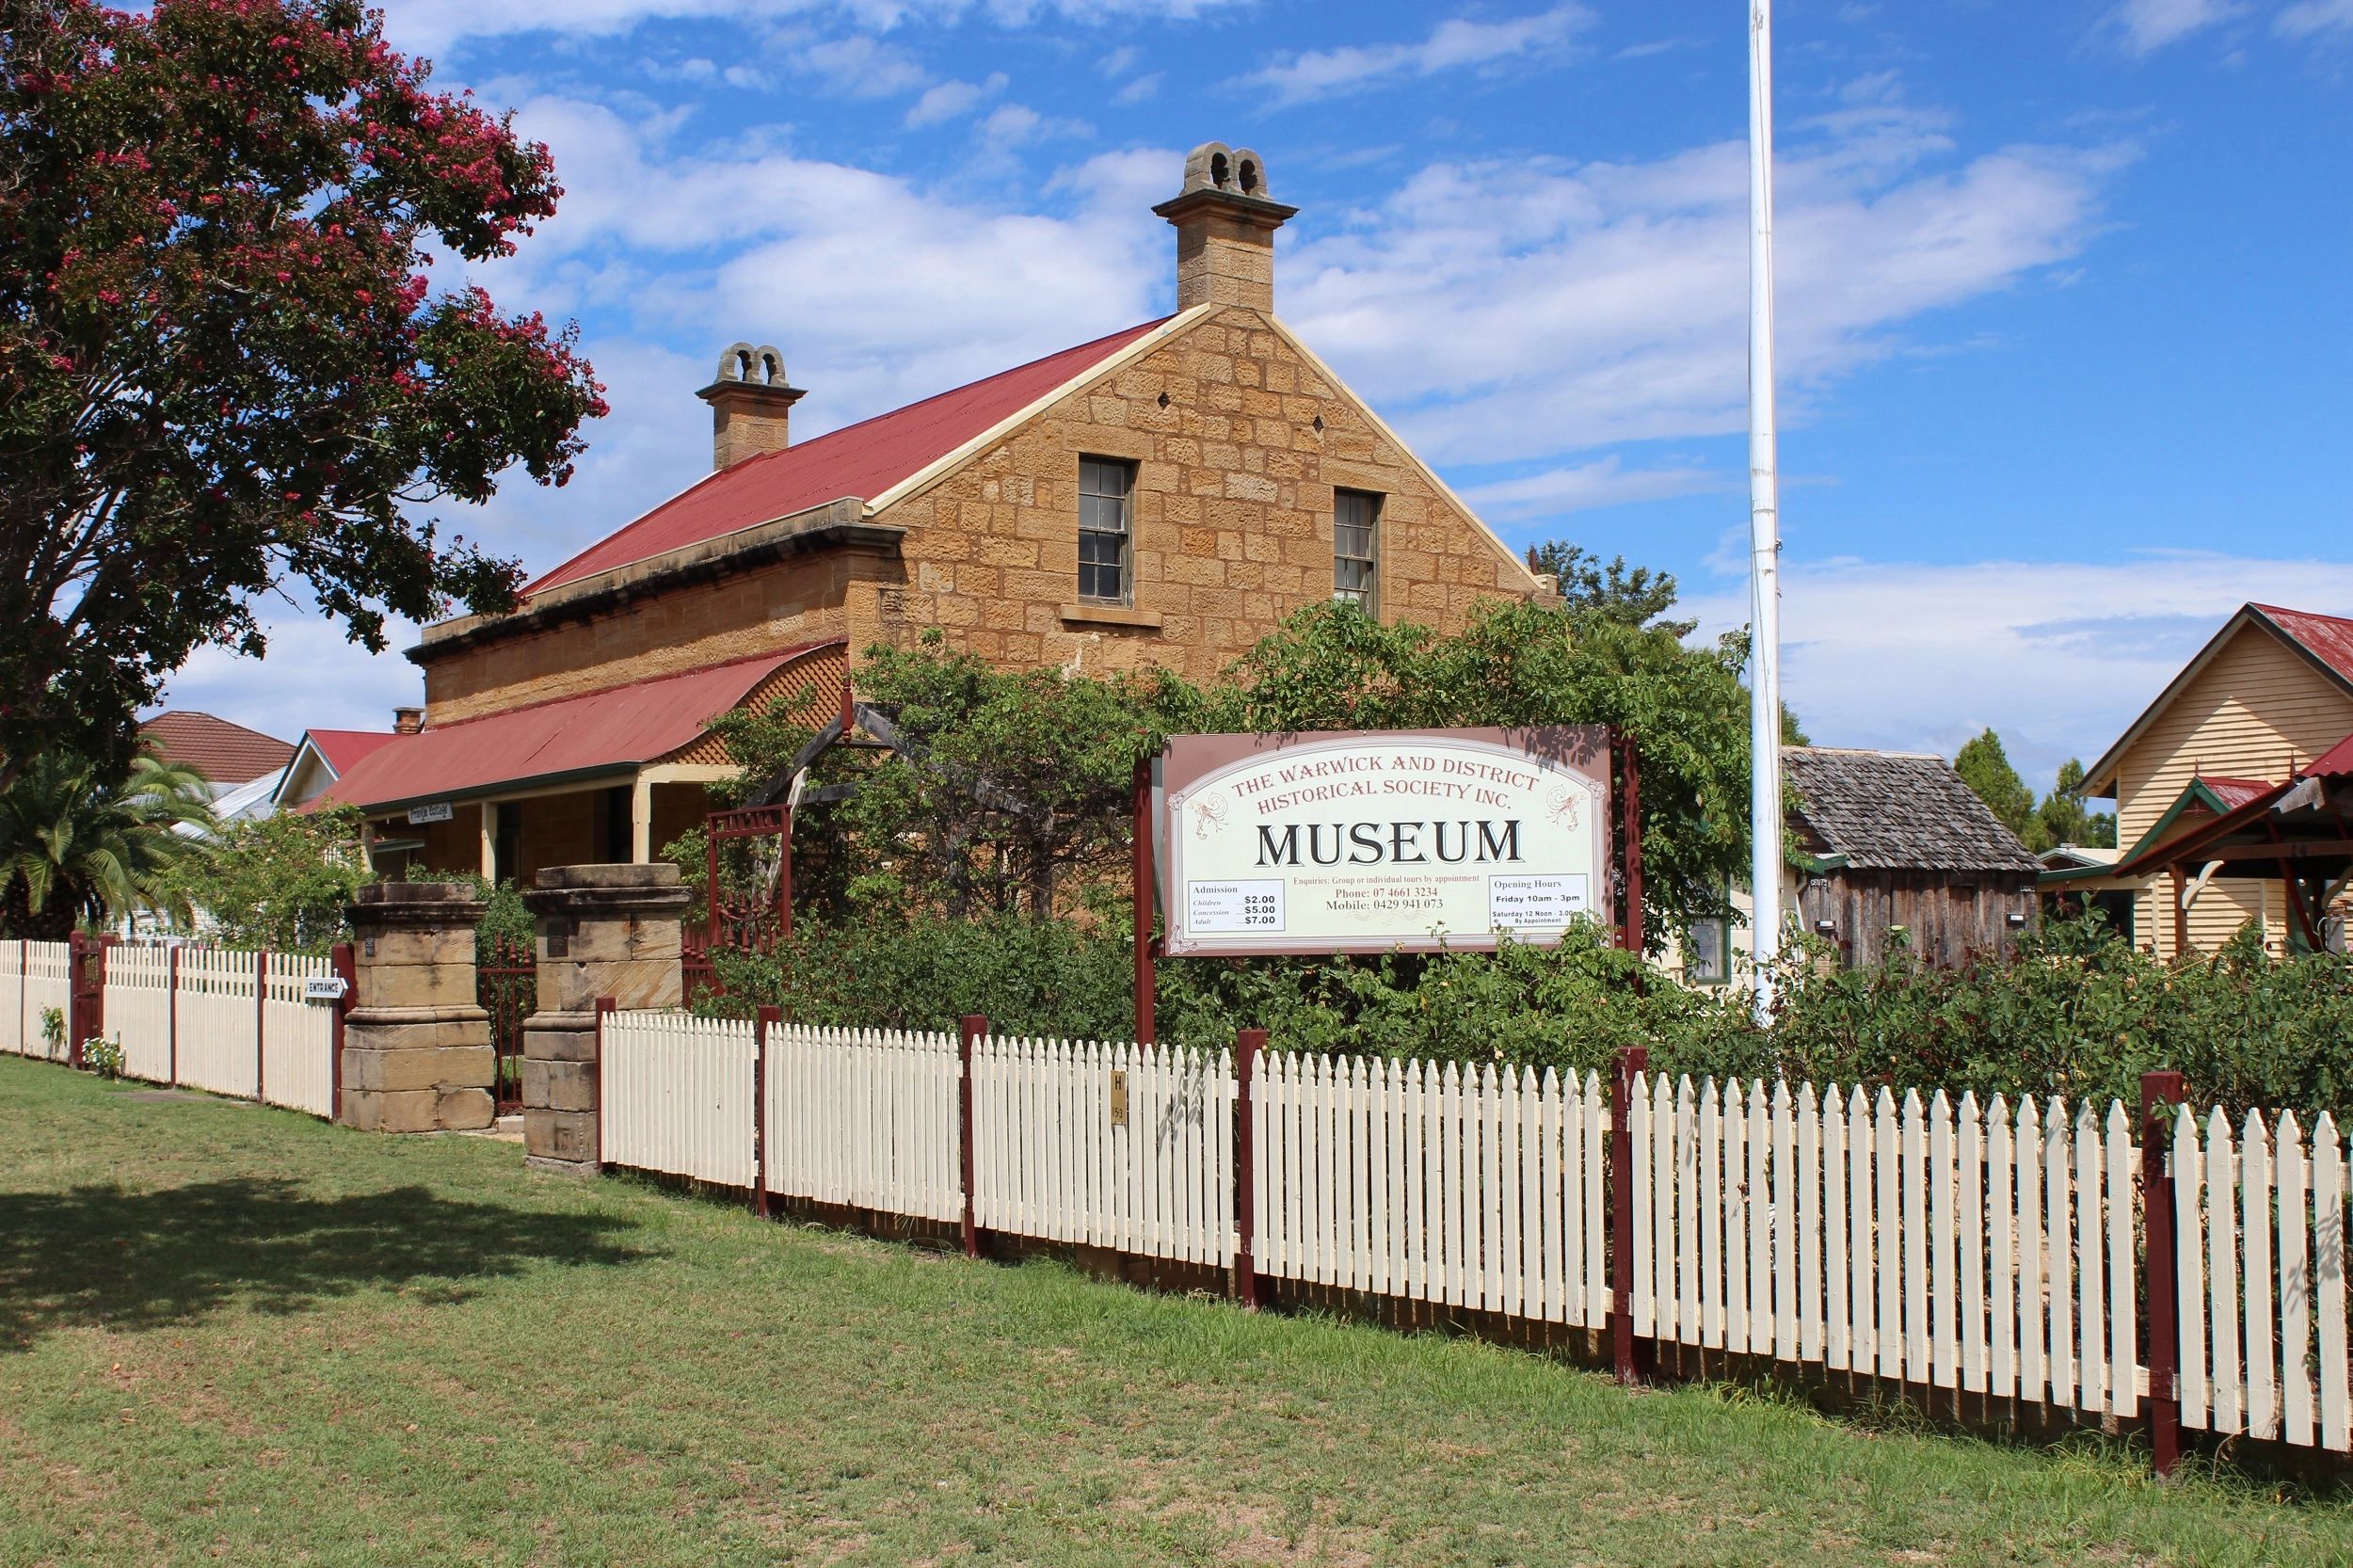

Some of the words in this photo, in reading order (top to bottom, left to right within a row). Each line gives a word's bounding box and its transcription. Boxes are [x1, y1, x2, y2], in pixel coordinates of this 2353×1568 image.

[1231, 774, 1273, 798] THE
[1278, 756, 1383, 783] WARWICK
[1391, 756, 1435, 770] AND
[1443, 759, 1540, 792] DISTRICT
[1257, 780, 1377, 815] HISTORICAL
[1384, 780, 1473, 799] SOCIETY
[1475, 788, 1511, 809] INC.
[1254, 820, 1526, 868] MUSEUM
[1293, 877, 1330, 886] Enquiries:
[1332, 876, 1355, 886] Group
[1366, 875, 1402, 884] individual
[1403, 875, 1423, 884] tours
[1424, 875, 1433, 885] by
[1434, 874, 1480, 885] appointment
[1494, 880, 1531, 890] Opening
[1193, 886, 1238, 894] Admission
[1336, 888, 1370, 899] Phone:
[1373, 888, 1385, 897] 07
[1387, 888, 1411, 897] 4661
[1414, 887, 1438, 897] 3234
[1244, 895, 1275, 904] $2.00
[1325, 901, 1370, 911] Mobile:
[1373, 900, 1400, 910] 0429
[1402, 900, 1420, 909] 941
[1423, 899, 1444, 909] 073
[1496, 895, 1524, 904] Friday
[1244, 905, 1275, 914] $5.00
[1244, 916, 1275, 924] $7.00
[310, 982, 338, 993] ENTRANCE
[1114, 1075, 1122, 1091] H
